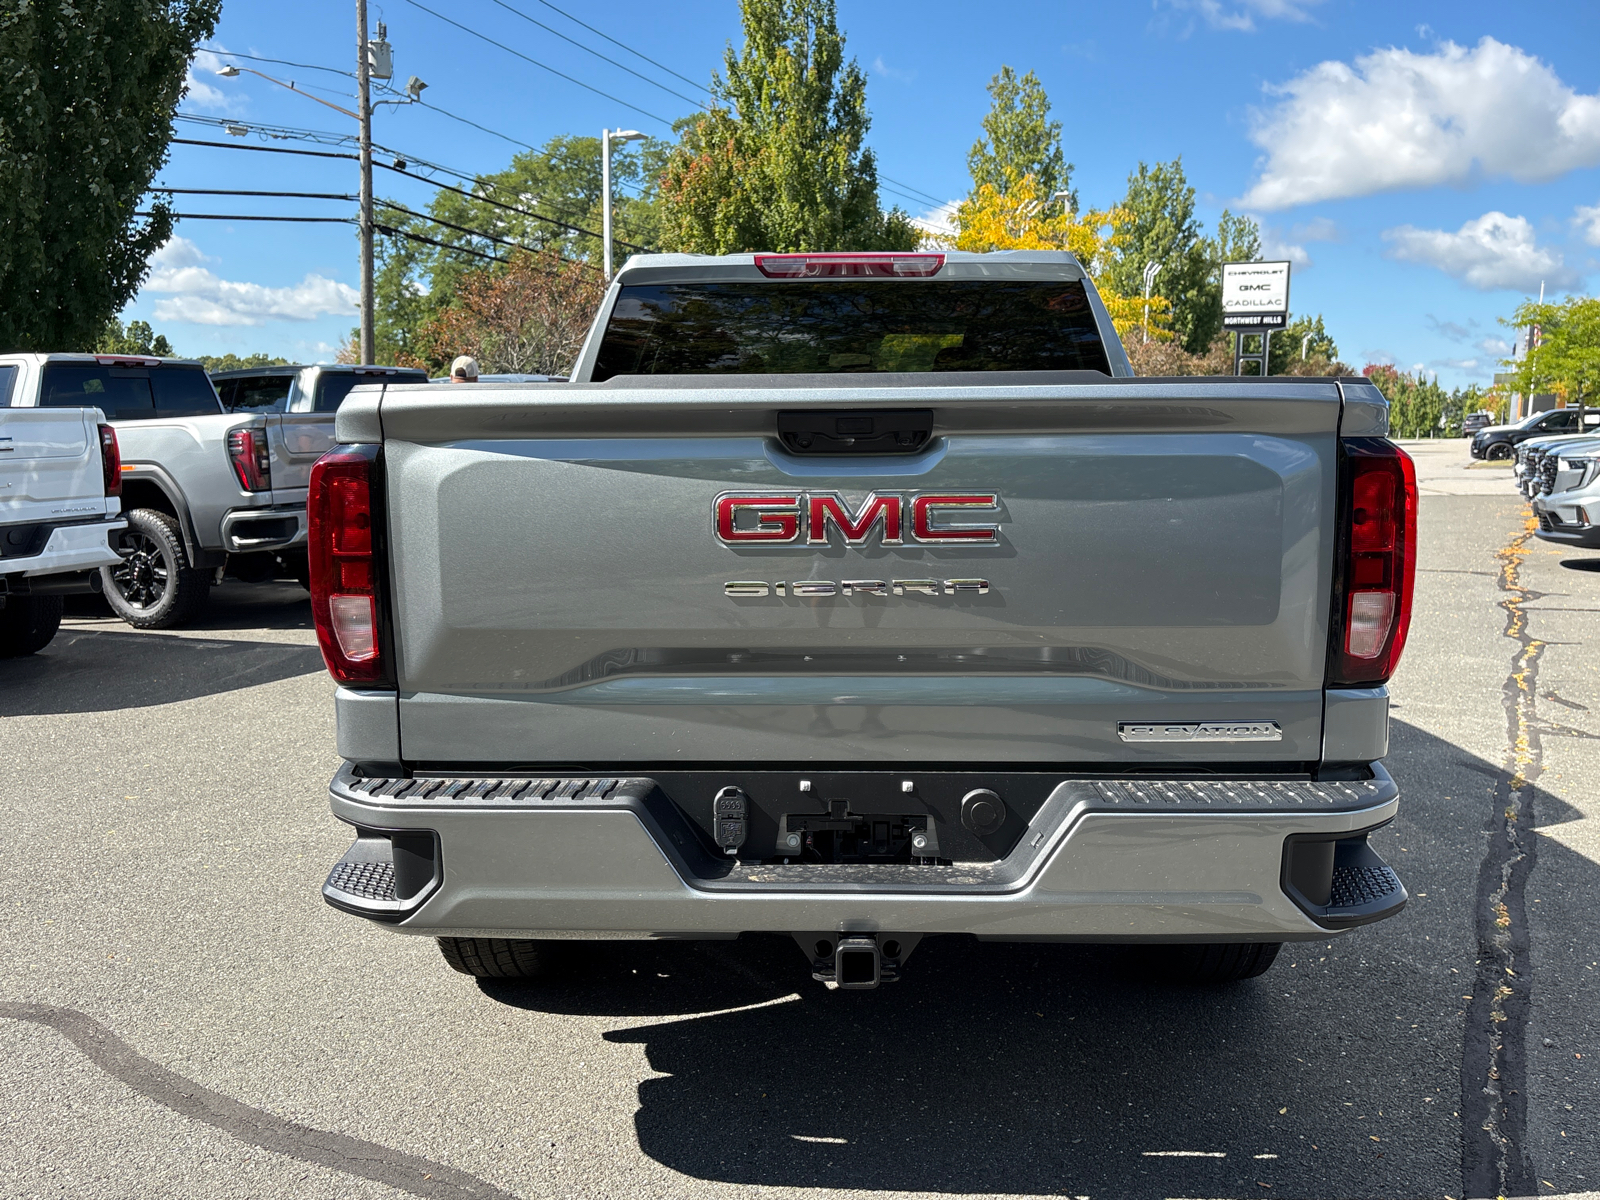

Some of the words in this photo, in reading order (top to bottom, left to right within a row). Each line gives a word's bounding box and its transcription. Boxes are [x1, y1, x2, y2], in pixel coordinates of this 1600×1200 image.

[1224, 316, 1262, 325] NORTHWEST
[1262, 315, 1282, 324] HILLS
[713, 490, 1000, 547] GMC
[724, 579, 989, 597] SIERRA
[1130, 725, 1271, 737] ELEVATION
